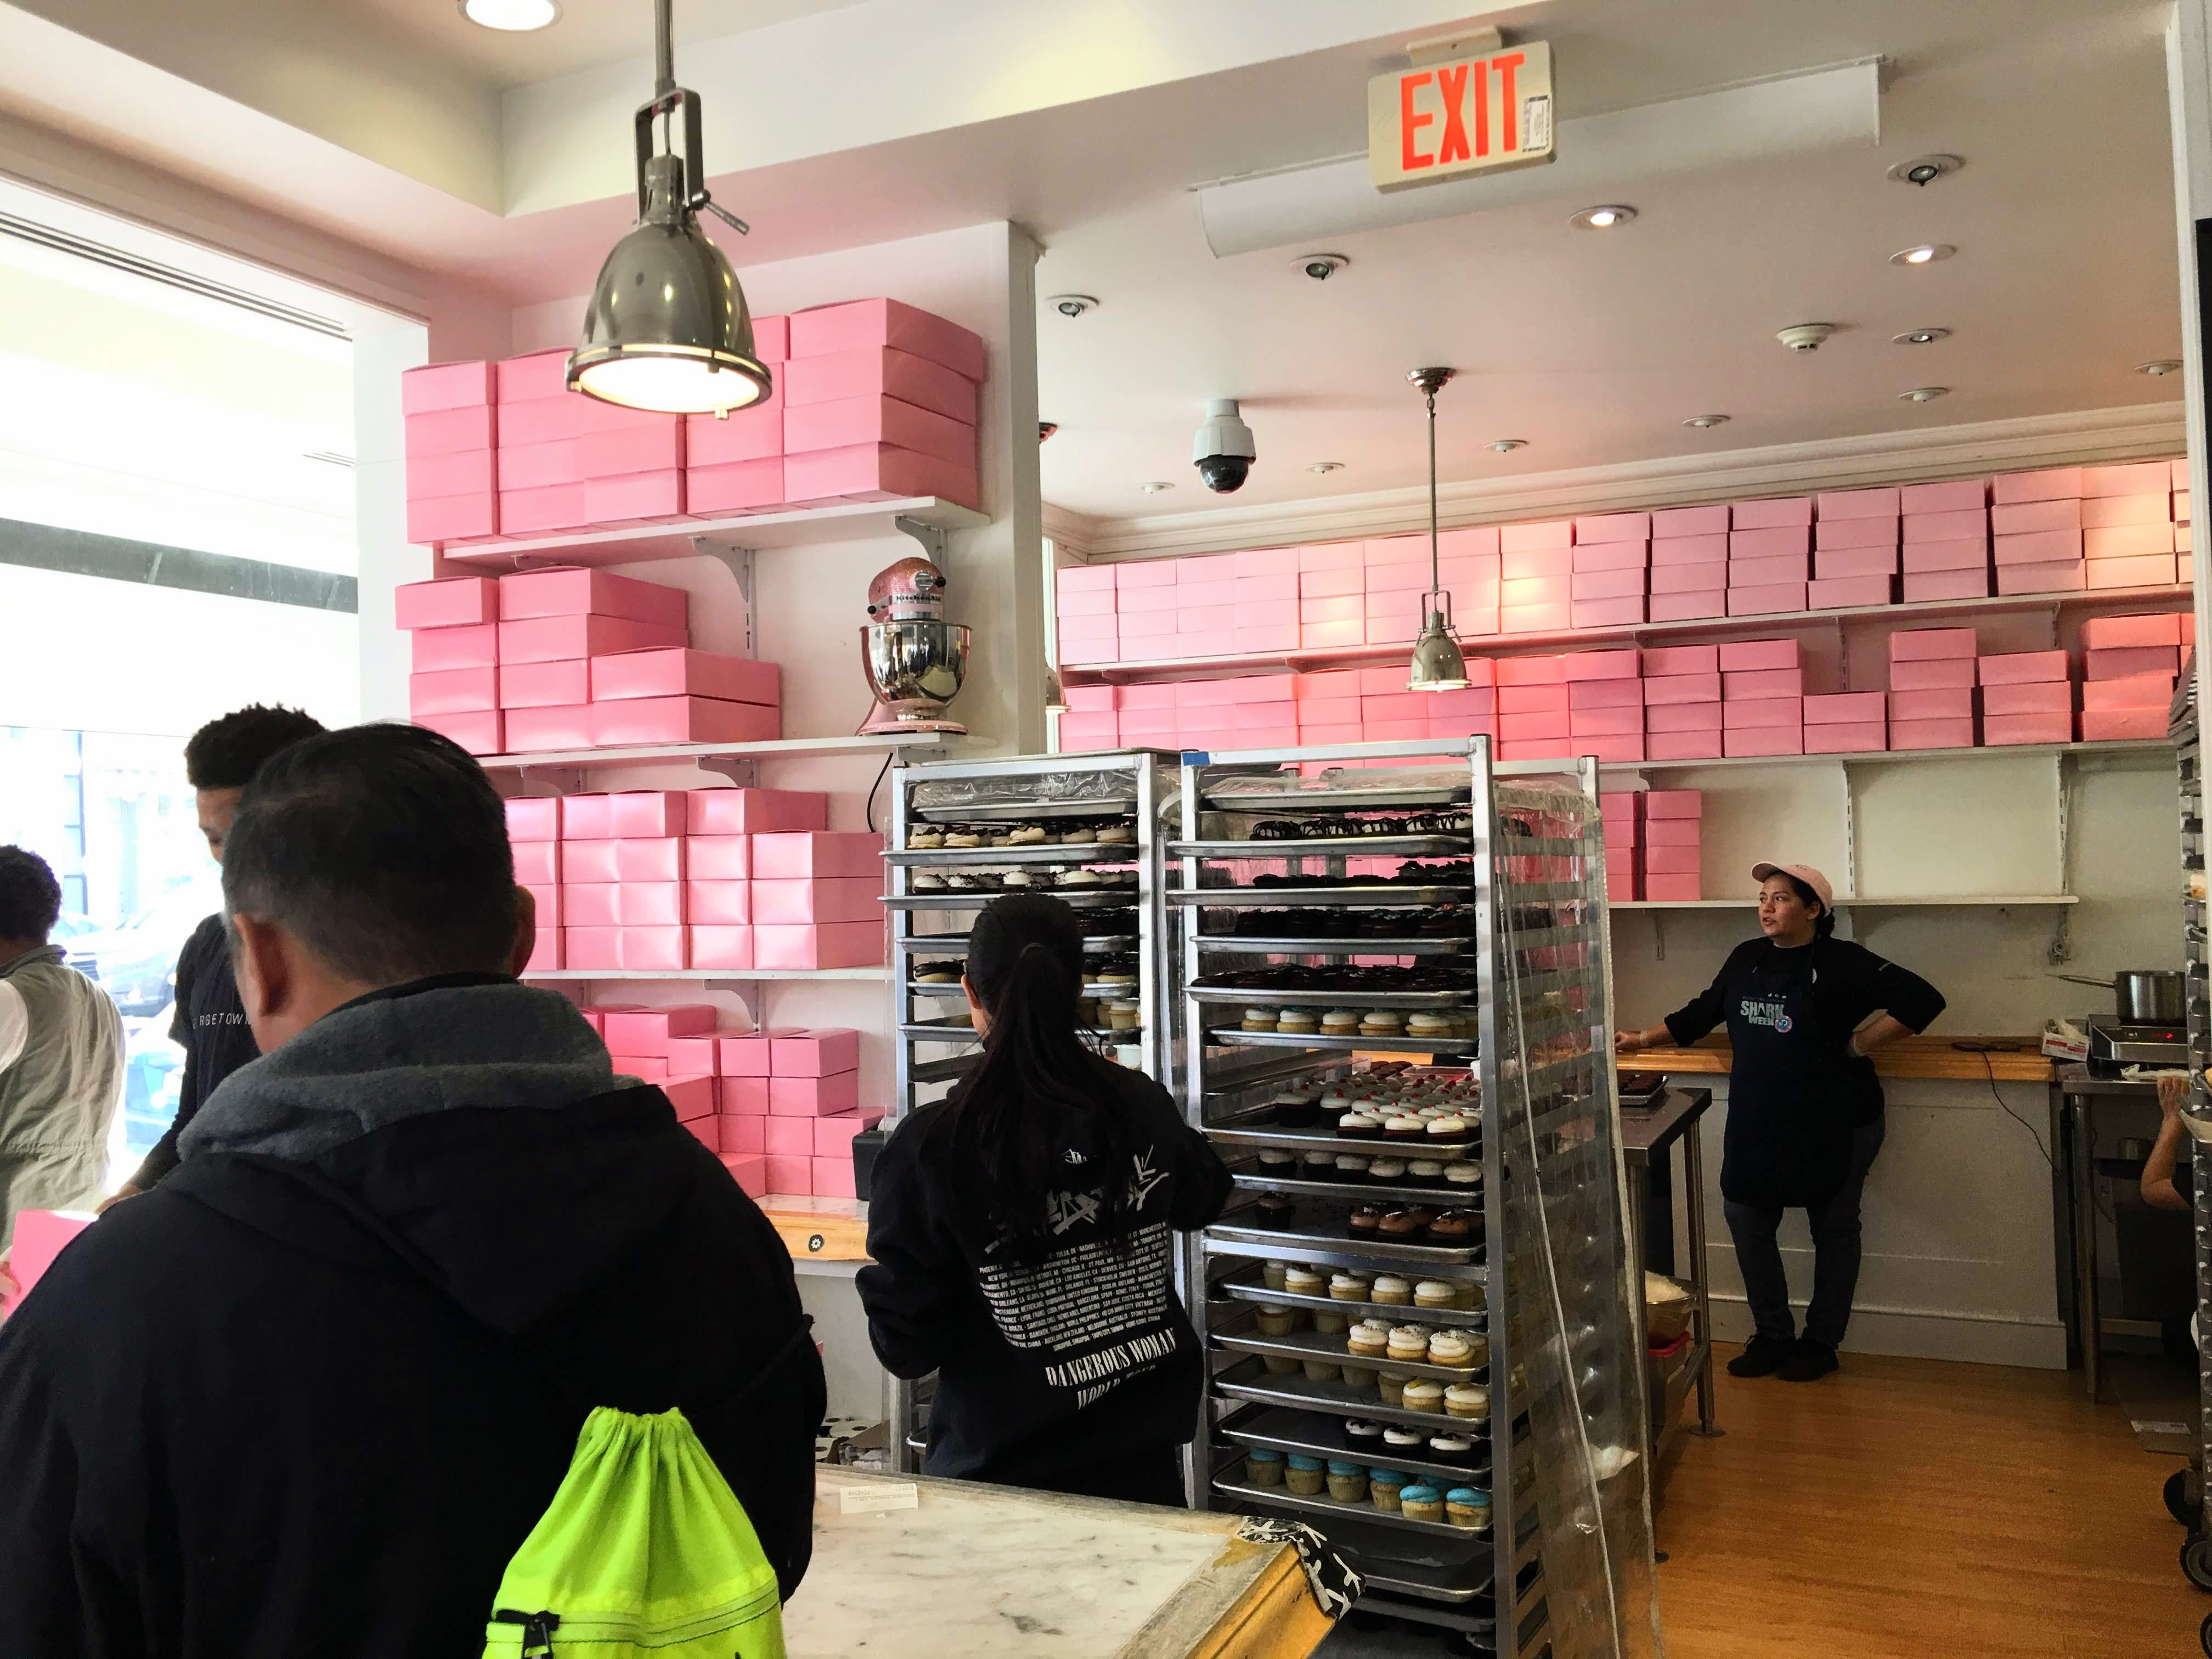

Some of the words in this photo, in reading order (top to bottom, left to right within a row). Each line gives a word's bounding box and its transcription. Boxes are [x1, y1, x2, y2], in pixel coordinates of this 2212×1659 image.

[1401, 52, 1525, 171] EXIT
[1740, 1000, 1785, 1019] SHARK
[1748, 1016, 1775, 1026] WEEK
[1045, 1344, 1130, 1387] DANGEROUS
[1127, 1327, 1177, 1363] WOMAN
